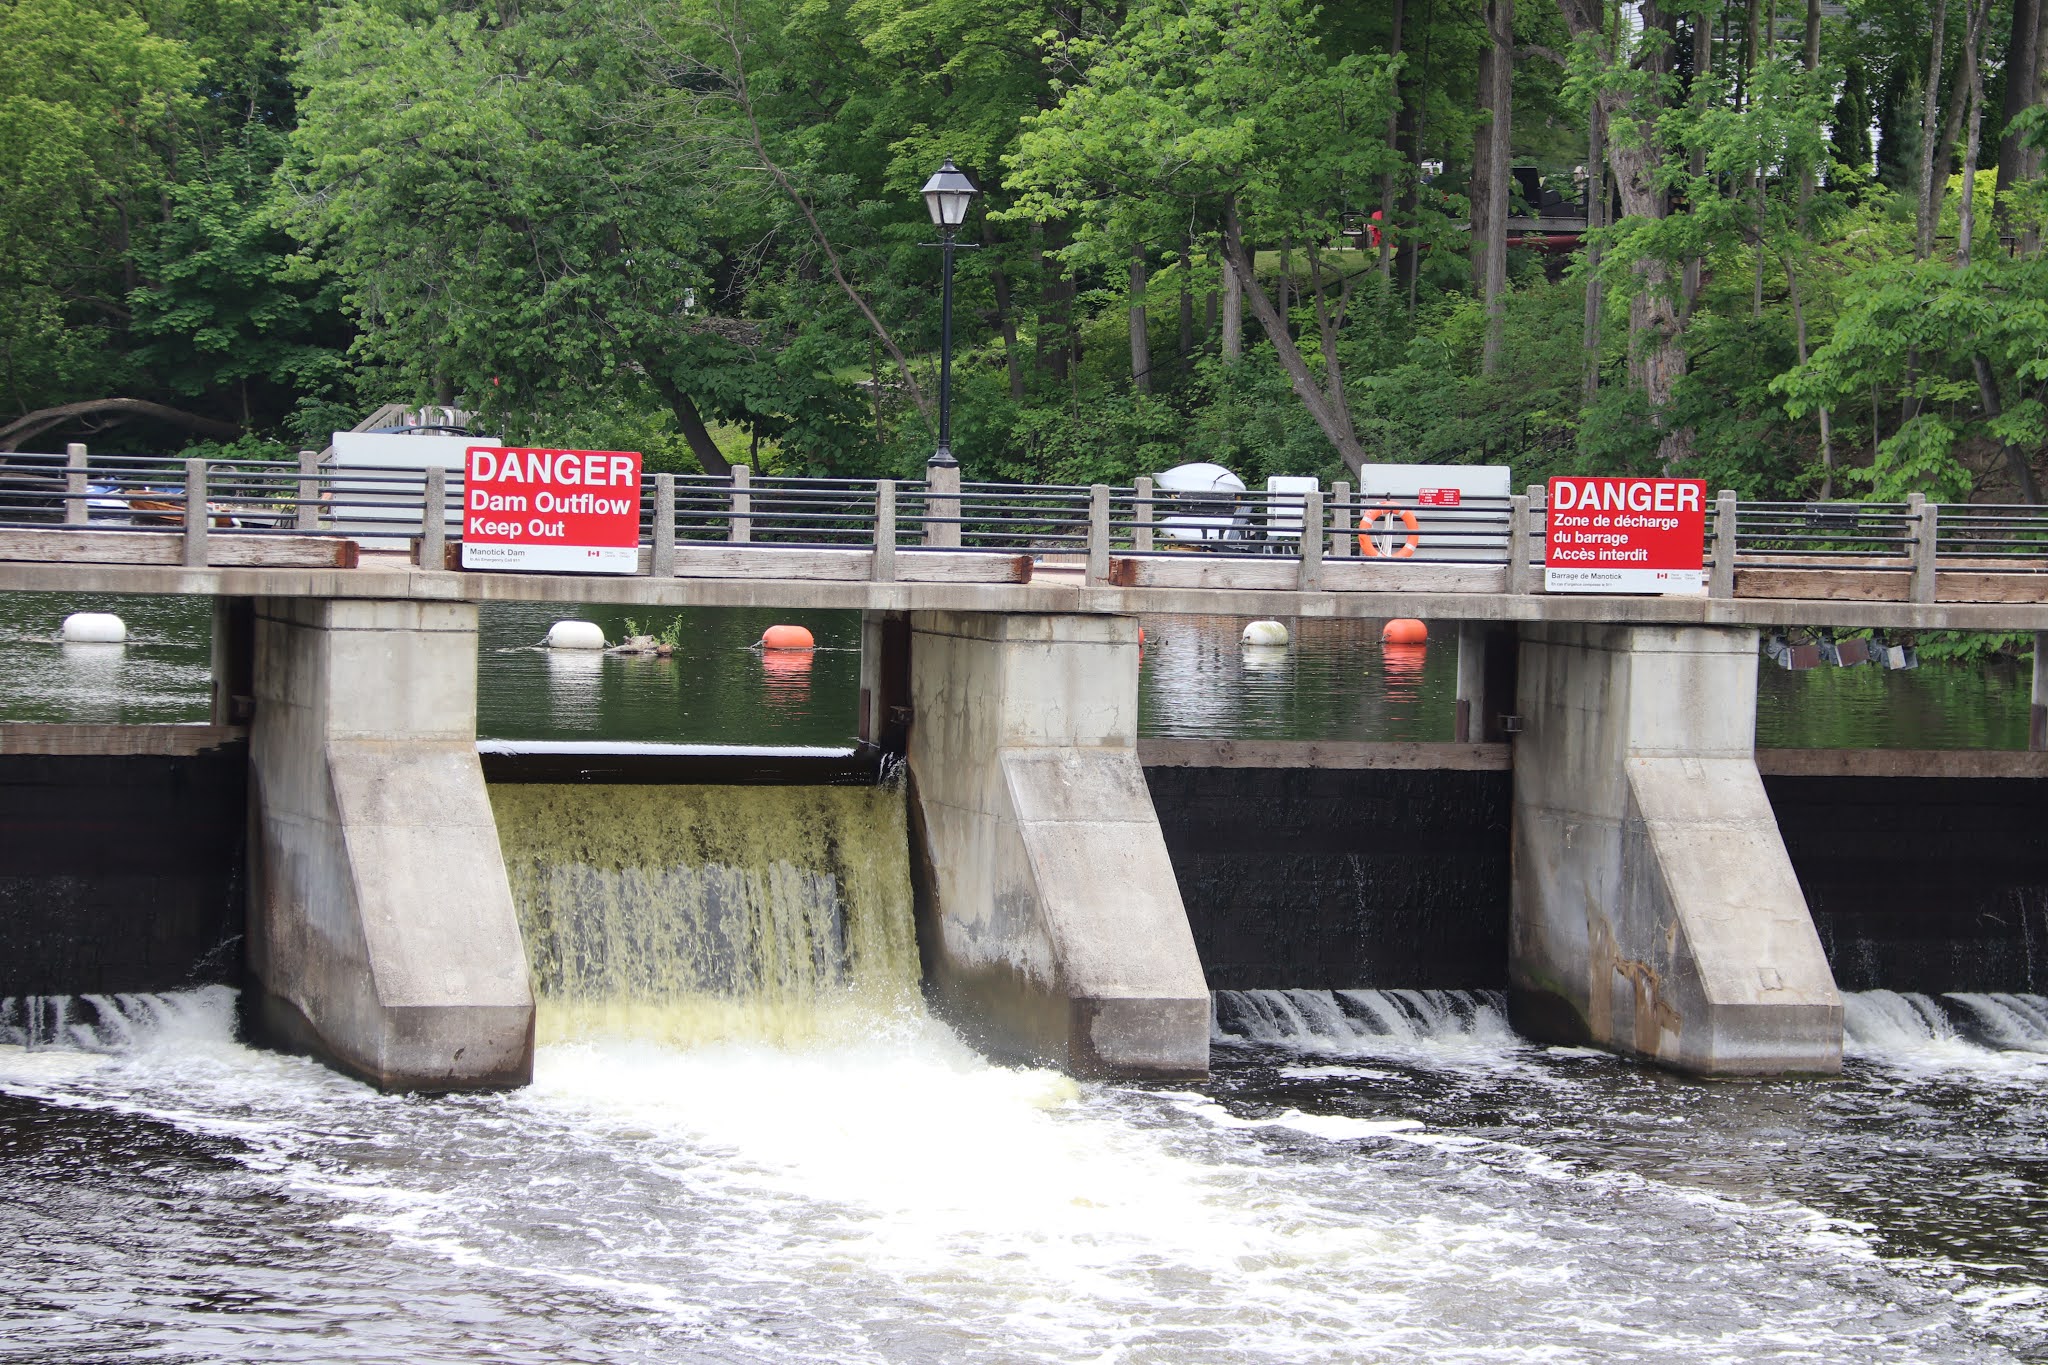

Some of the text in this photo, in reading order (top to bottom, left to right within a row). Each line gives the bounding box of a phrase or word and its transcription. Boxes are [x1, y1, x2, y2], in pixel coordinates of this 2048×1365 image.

[471, 451, 634, 487] DANGER
[471, 489, 631, 515] Dam Outflow
[1554, 481, 1699, 512] DANGER
[470, 517, 564, 539] Keep Out
[1554, 513, 1679, 531] Zone de décharge
[1553, 531, 1628, 546] du barrage
[470, 548, 505, 556] Manotick
[1552, 547, 1648, 561] Accès interdit
[1551, 572, 1578, 580] Barrage
[1591, 572, 1622, 580] Manotick
